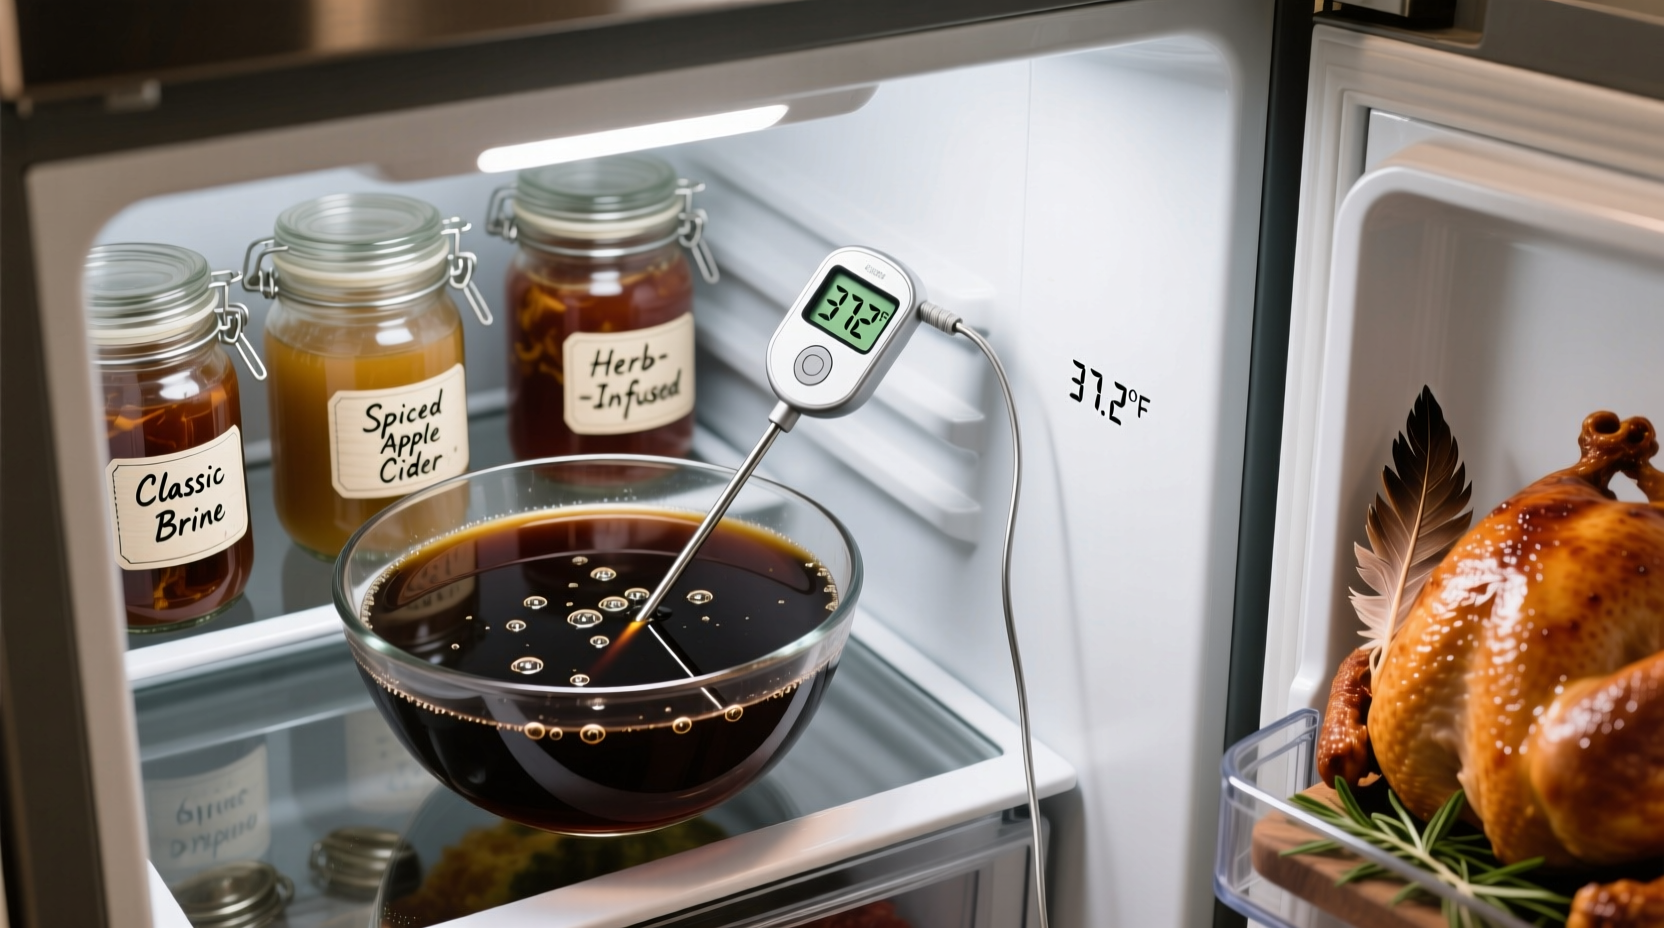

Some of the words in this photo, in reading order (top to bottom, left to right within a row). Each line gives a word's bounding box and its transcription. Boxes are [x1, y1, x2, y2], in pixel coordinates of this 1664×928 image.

[590, 343, 669, 378] Herb-
[362, 387, 443, 440] Spiced
[380, 422, 440, 458] Apple
[135, 465, 225, 507] Classic
[379, 450, 443, 484] Cider
[155, 503, 226, 543] Brine
